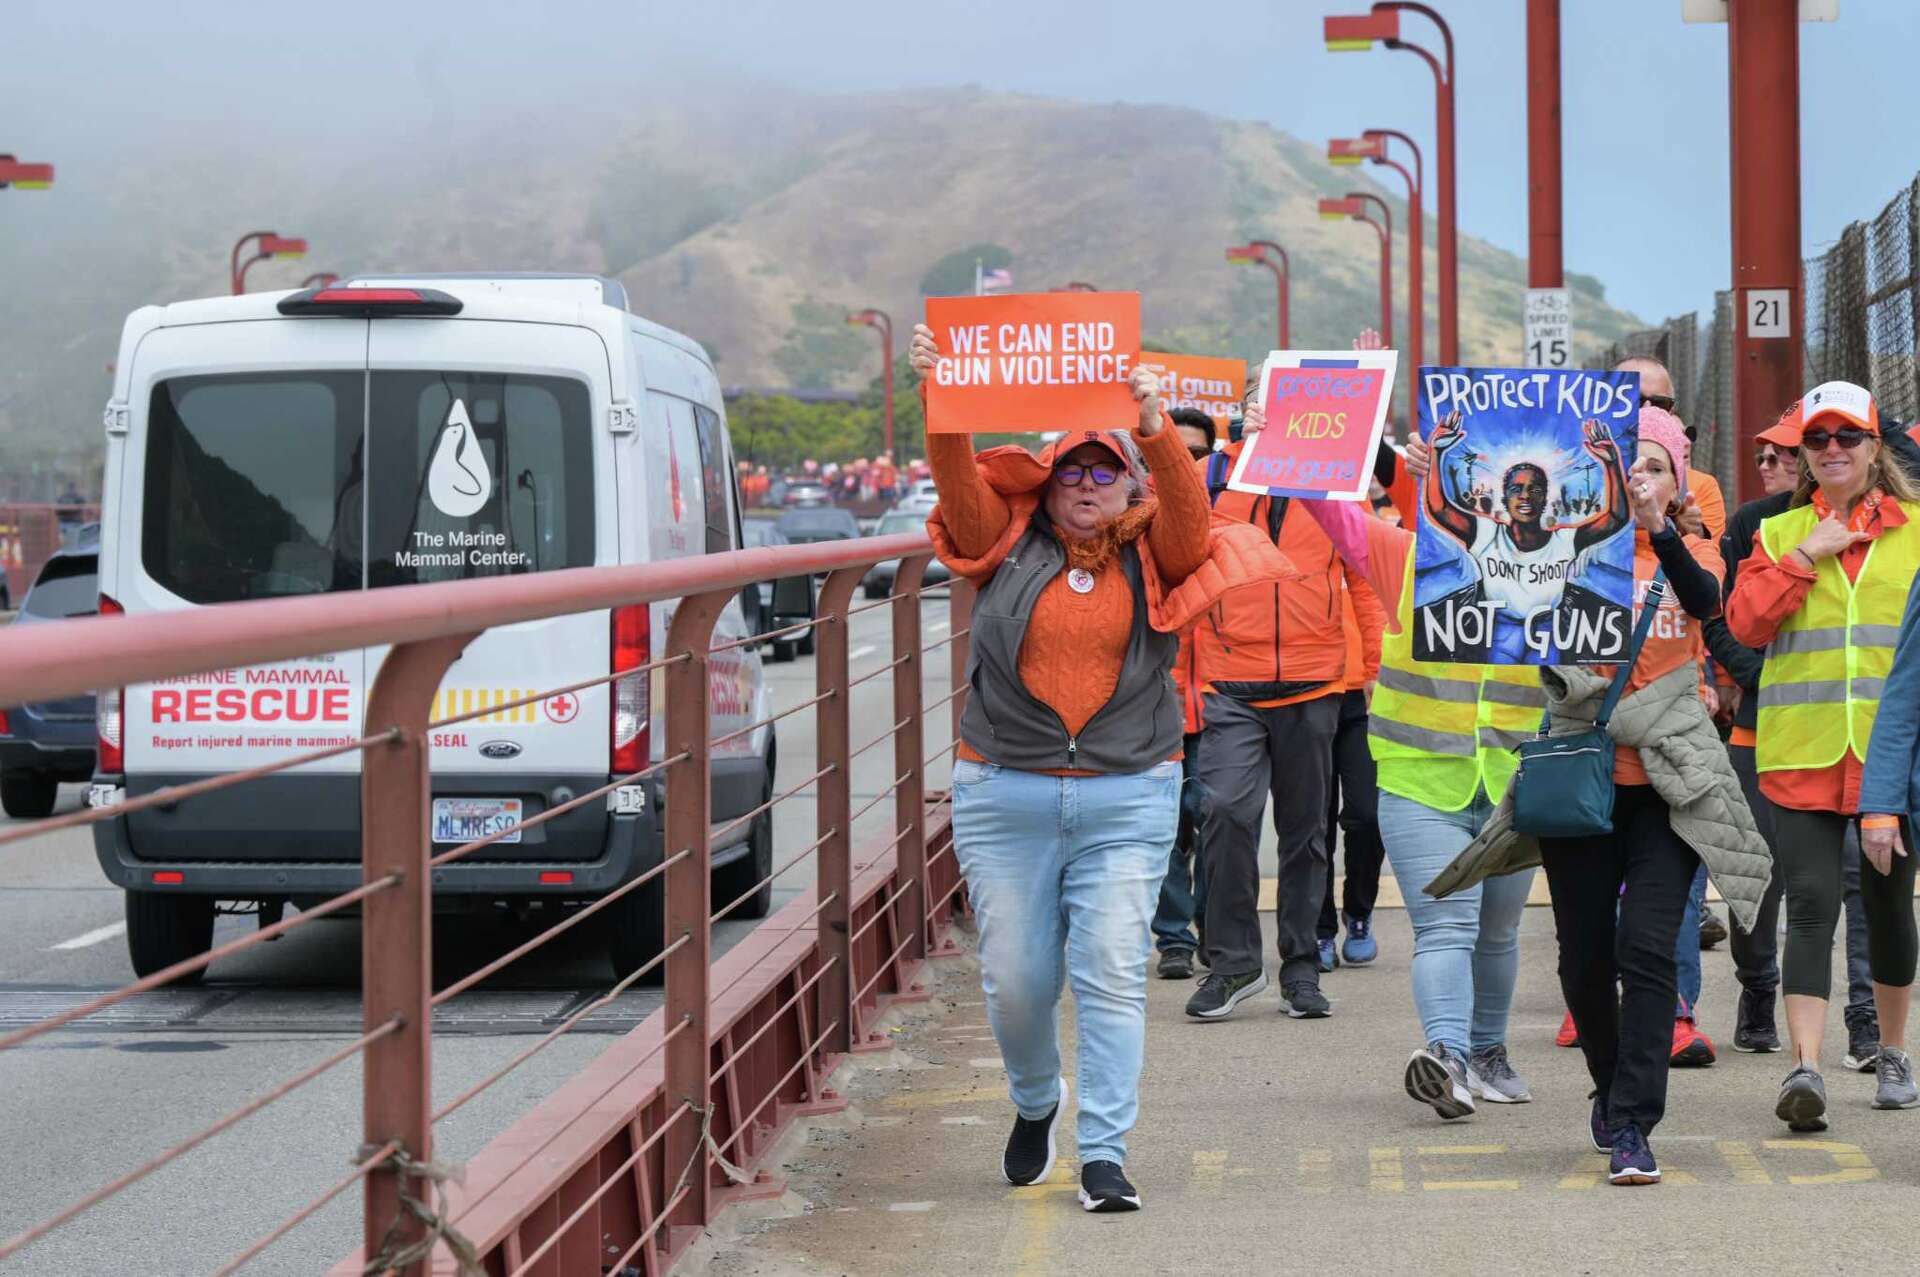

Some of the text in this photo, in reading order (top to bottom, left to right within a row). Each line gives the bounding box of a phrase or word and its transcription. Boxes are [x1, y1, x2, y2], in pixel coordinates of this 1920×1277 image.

[1528, 313, 1568, 325] SPEED
[1754, 299, 1779, 327] 21
[949, 322, 1115, 355] WE CAN END
[1532, 327, 1563, 338] LIMIT
[1530, 339, 1568, 367] 15
[935, 356, 991, 386] GUN
[999, 354, 1131, 385] VIOLENCE
[1181, 376, 1233, 399] gun
[1276, 372, 1374, 405] protect
[1557, 373, 1633, 419] KIDS
[1286, 411, 1347, 439] KIDS
[1251, 455, 1357, 486] not guns
[413, 530, 506, 547] The Marine
[395, 551, 465, 567] Mammal
[1529, 559, 1570, 584] SHOOT
[1423, 599, 1623, 659] NOT GUNS
[245, 669, 351, 685] MAMMAL
[152, 688, 350, 724] RESCUE
[152, 735, 193, 749] Report
[197, 735, 243, 749] injured
[248, 736, 292, 747] marine
